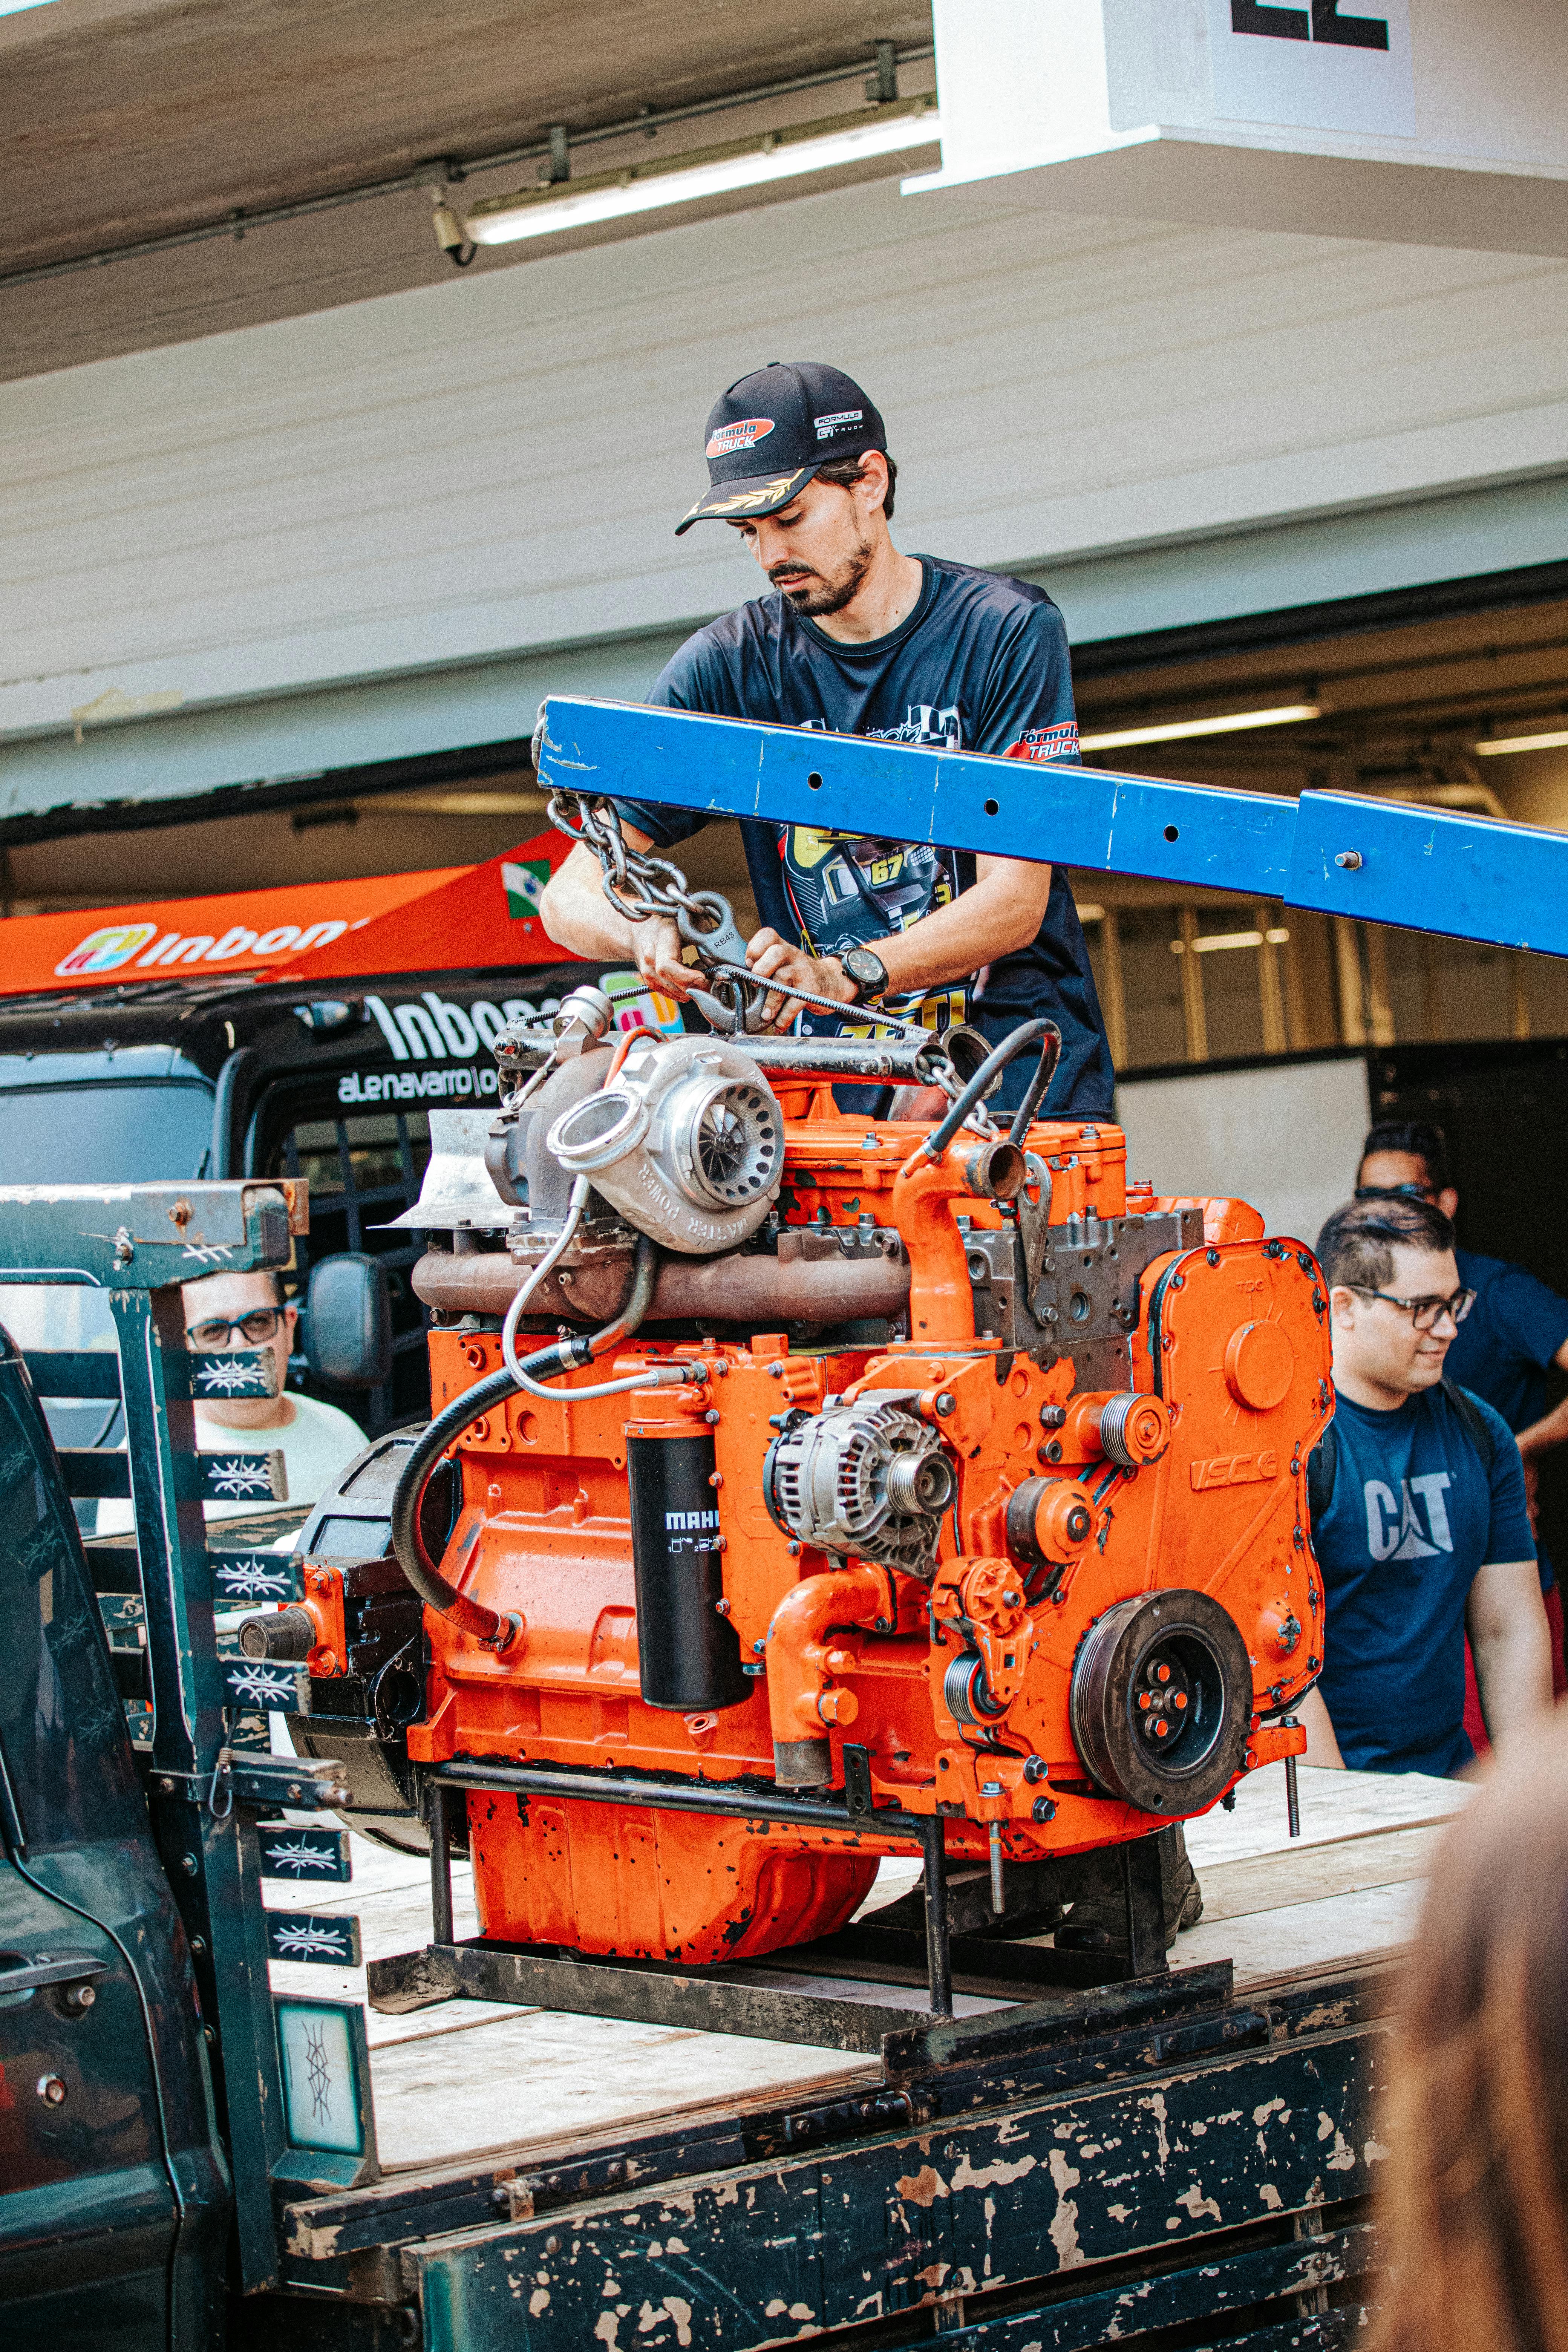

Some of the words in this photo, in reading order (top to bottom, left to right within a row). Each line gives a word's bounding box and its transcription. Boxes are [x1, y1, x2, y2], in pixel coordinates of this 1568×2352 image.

[717, 435, 754, 452] TRUCK
[835, 424, 863, 433] TRUCK
[1029, 741, 1080, 759] TRUCK
[871, 853, 904, 885] 67
[136, 917, 371, 968] Inbon
[714, 932, 735, 949] RB48
[364, 992, 561, 1060] Inbo
[1018, 1116, 1035, 1146] GRASE
[638, 1163, 680, 1220] POWER
[688, 1217, 748, 1242] MASTER
[1364, 1472, 1453, 1561] CAT
